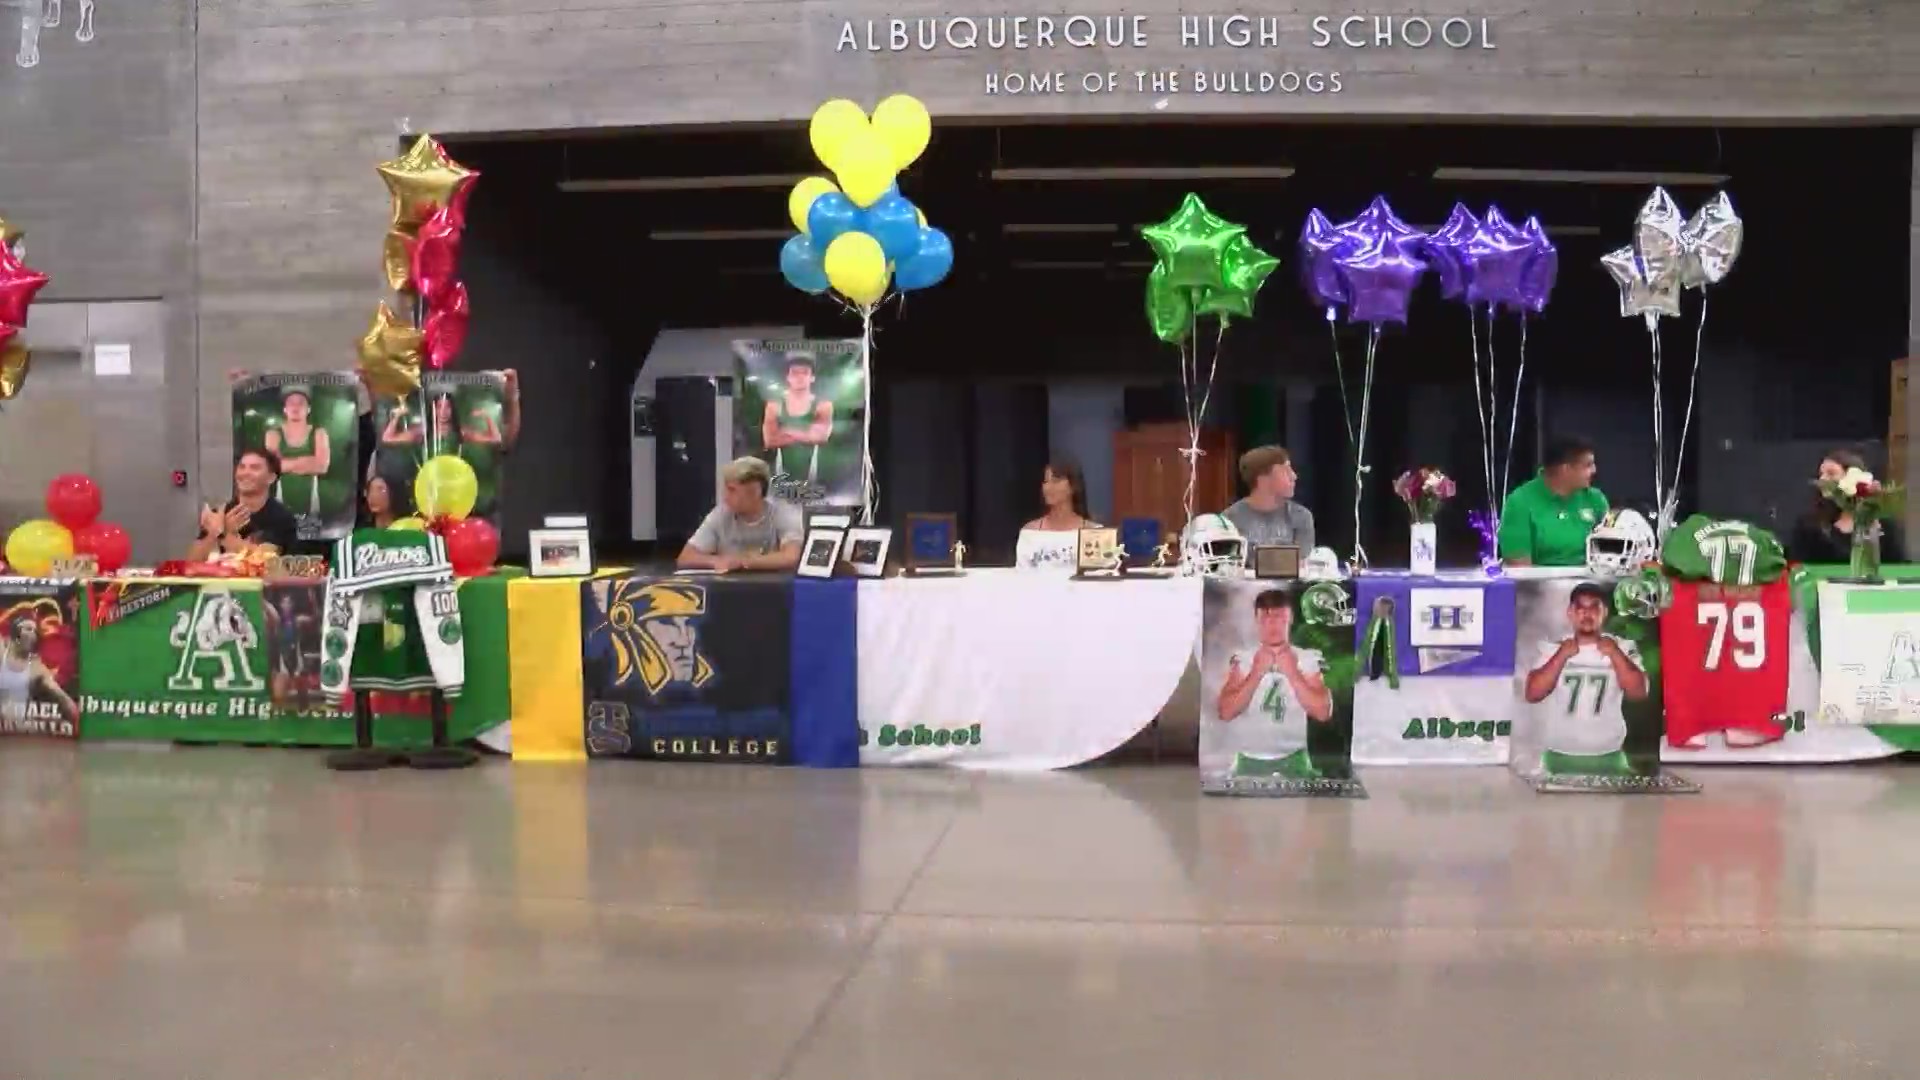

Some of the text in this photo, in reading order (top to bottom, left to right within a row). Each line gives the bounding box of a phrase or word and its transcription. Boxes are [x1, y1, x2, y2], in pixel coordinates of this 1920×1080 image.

[836, 16, 1497, 52] ALBUQUERQUE HIGH SCHOOL
[986, 72, 1344, 96] HOME OF THE BULLDOGS
[354, 543, 430, 570] Ramos
[1699, 536, 1757, 586] 77
[433, 592, 459, 614] 100
[1698, 602, 1765, 668] 79
[1260, 680, 1286, 723] 4
[1563, 674, 1609, 714] 77
[228, 697, 285, 720] Hig
[653, 738, 778, 754] COLLEGE
[878, 724, 981, 746] School
